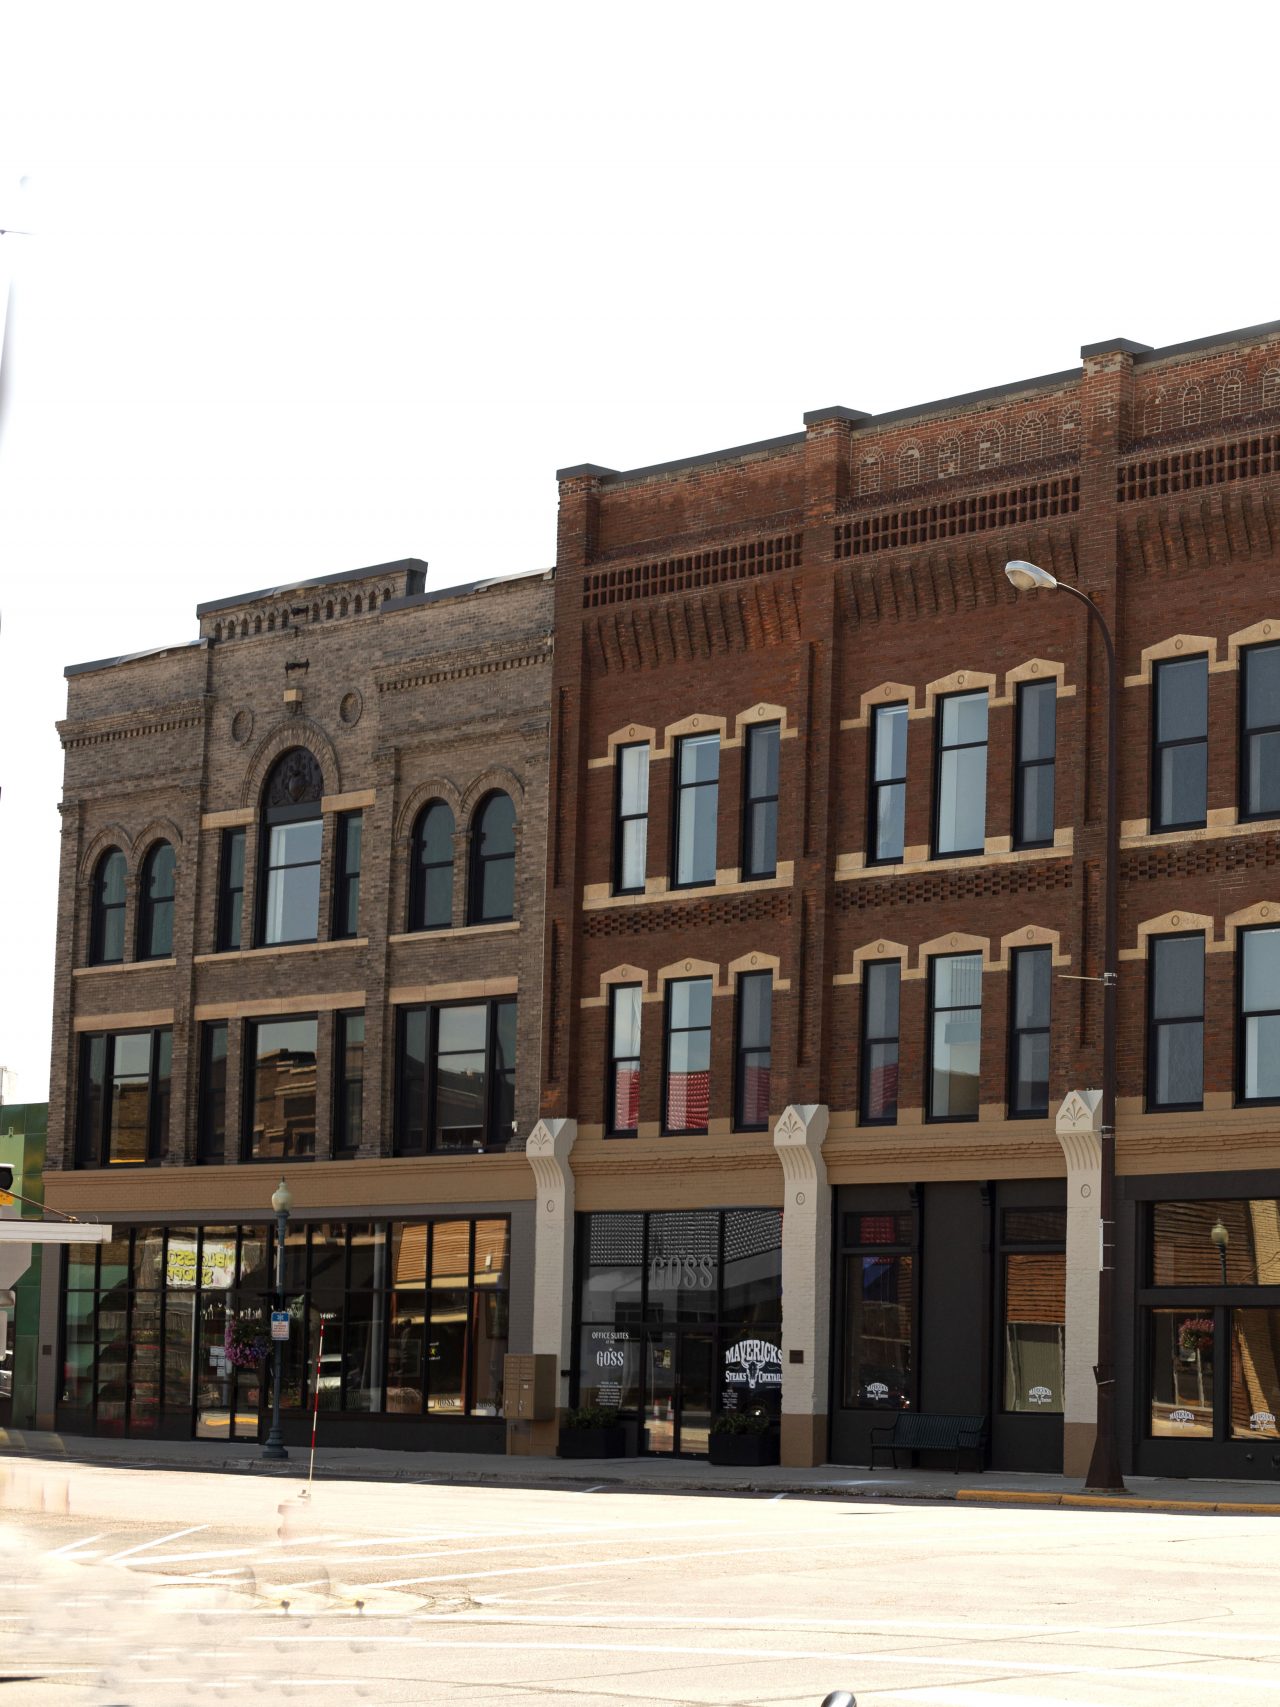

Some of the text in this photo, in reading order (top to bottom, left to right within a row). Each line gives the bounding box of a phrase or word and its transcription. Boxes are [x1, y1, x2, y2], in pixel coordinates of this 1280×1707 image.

[651, 1255, 714, 1290] GOSS
[591, 1331, 629, 1340] OFFICE SUITES
[596, 1350, 624, 1367] GOSS
[725, 1339, 783, 1365] MAVERICKS
[725, 1370, 747, 1383] STEAKS
